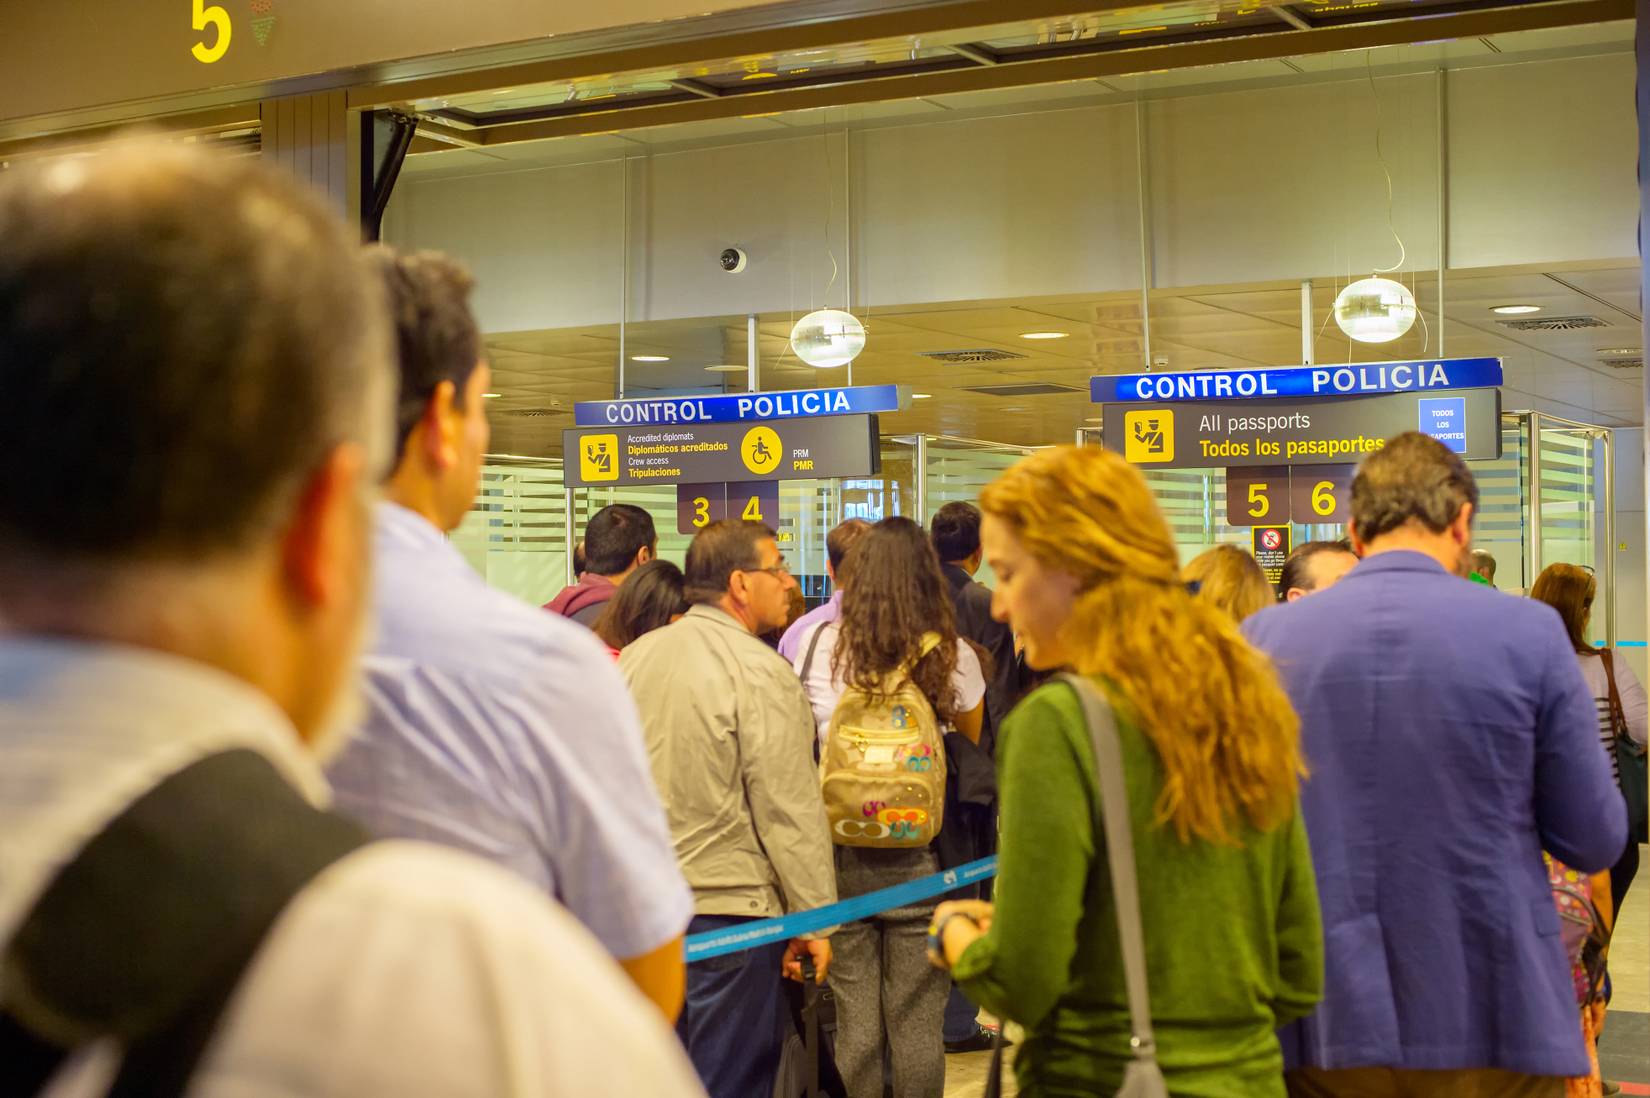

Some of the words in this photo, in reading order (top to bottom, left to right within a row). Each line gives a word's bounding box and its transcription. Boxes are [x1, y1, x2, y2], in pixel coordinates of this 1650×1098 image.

[191, 0, 232, 63] 5
[1136, 373, 1278, 399] CONTROL
[1312, 364, 1450, 392] POLICIA
[606, 401, 712, 423] CONTROL
[738, 391, 850, 418] POLICIA
[1431, 409, 1454, 417] TODOS
[1199, 414, 1221, 432] All
[1228, 412, 1311, 434] passports
[1436, 421, 1450, 429] LOS
[627, 433, 662, 443] Accredited
[662, 432, 694, 443] diplomats
[628, 444, 679, 456] Diplomáticos
[681, 441, 728, 453] acreditados
[793, 448, 809, 458] PRM
[1199, 439, 1249, 457] Todos
[1256, 438, 1280, 456] los
[1287, 435, 1385, 459] pasaportes
[628, 457, 645, 466] Crew
[646, 457, 669, 465] access
[793, 460, 814, 471] PMR
[628, 467, 681, 479] Tripulaciones
[1247, 483, 1270, 518] 5
[1311, 480, 1337, 516] 6
[692, 496, 710, 528] 3
[742, 495, 763, 521] 4
